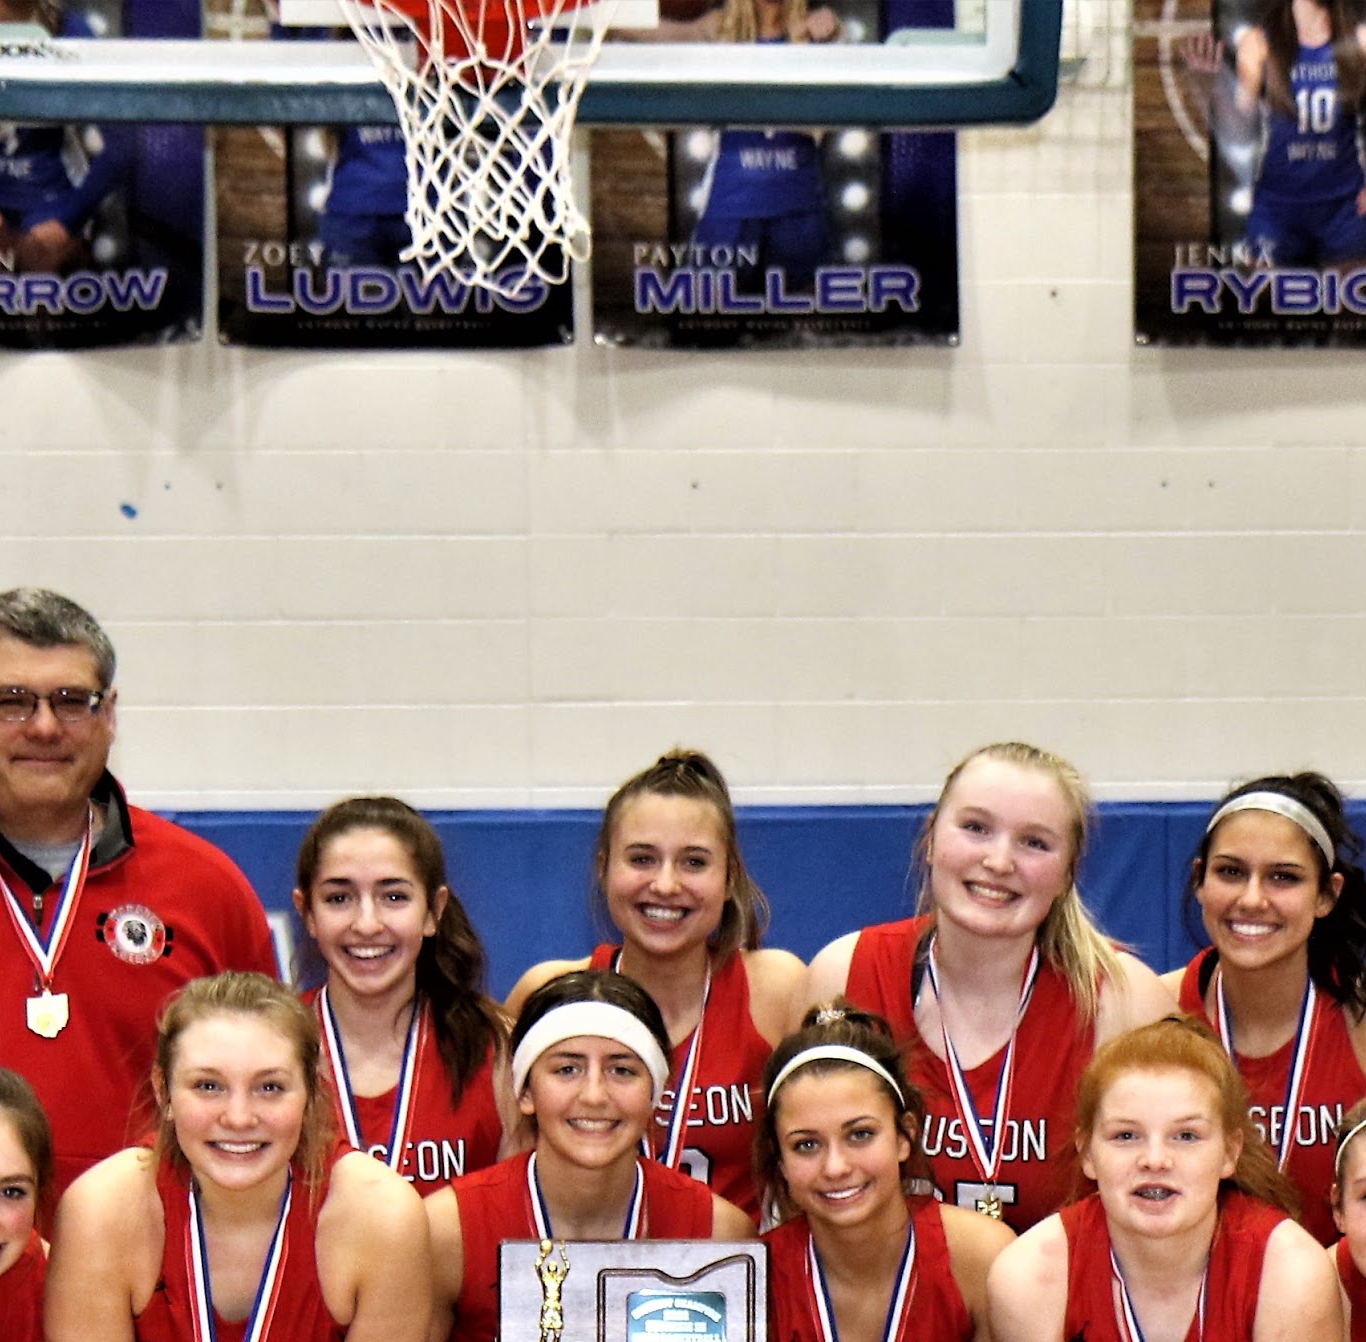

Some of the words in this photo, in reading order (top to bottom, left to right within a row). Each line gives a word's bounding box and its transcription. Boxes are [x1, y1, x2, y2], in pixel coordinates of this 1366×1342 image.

[1295, 88, 1336, 134] 10
[740, 148, 798, 170] WAYNE
[242, 242, 327, 267] ZOEY
[635, 243, 759, 268] PAYTON
[1174, 238, 1275, 268] JENNA
[245, 264, 551, 315] LUDWIG
[635, 266, 921, 314] MILLER
